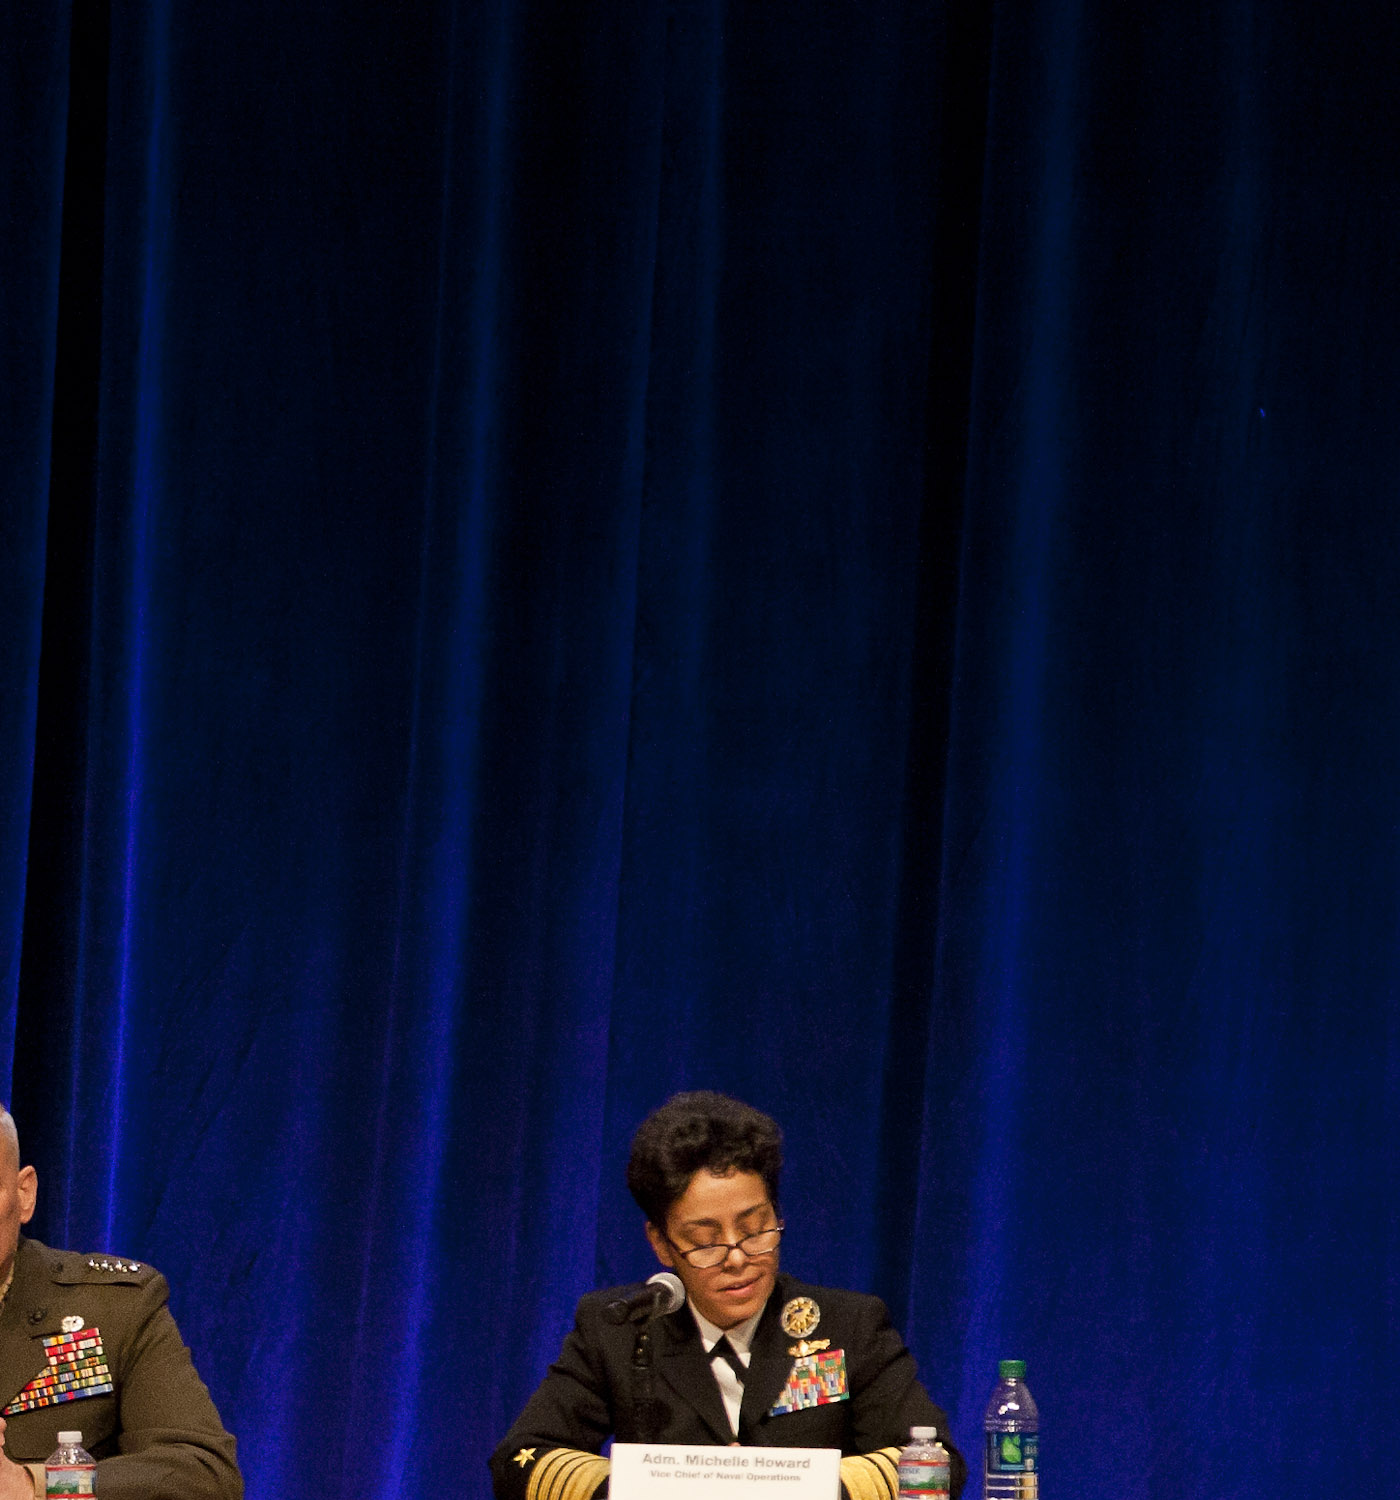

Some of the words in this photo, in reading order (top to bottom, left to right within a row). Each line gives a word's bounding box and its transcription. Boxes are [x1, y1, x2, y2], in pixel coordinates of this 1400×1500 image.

[643, 1454, 679, 1464] Adm.
[686, 1455, 749, 1467] Michelle
[755, 1458, 811, 1469] Howard
[650, 1470, 671, 1478] Vice
[674, 1471, 700, 1479] Chief
[716, 1472, 743, 1480] Naval
[747, 1473, 800, 1481] Operations
